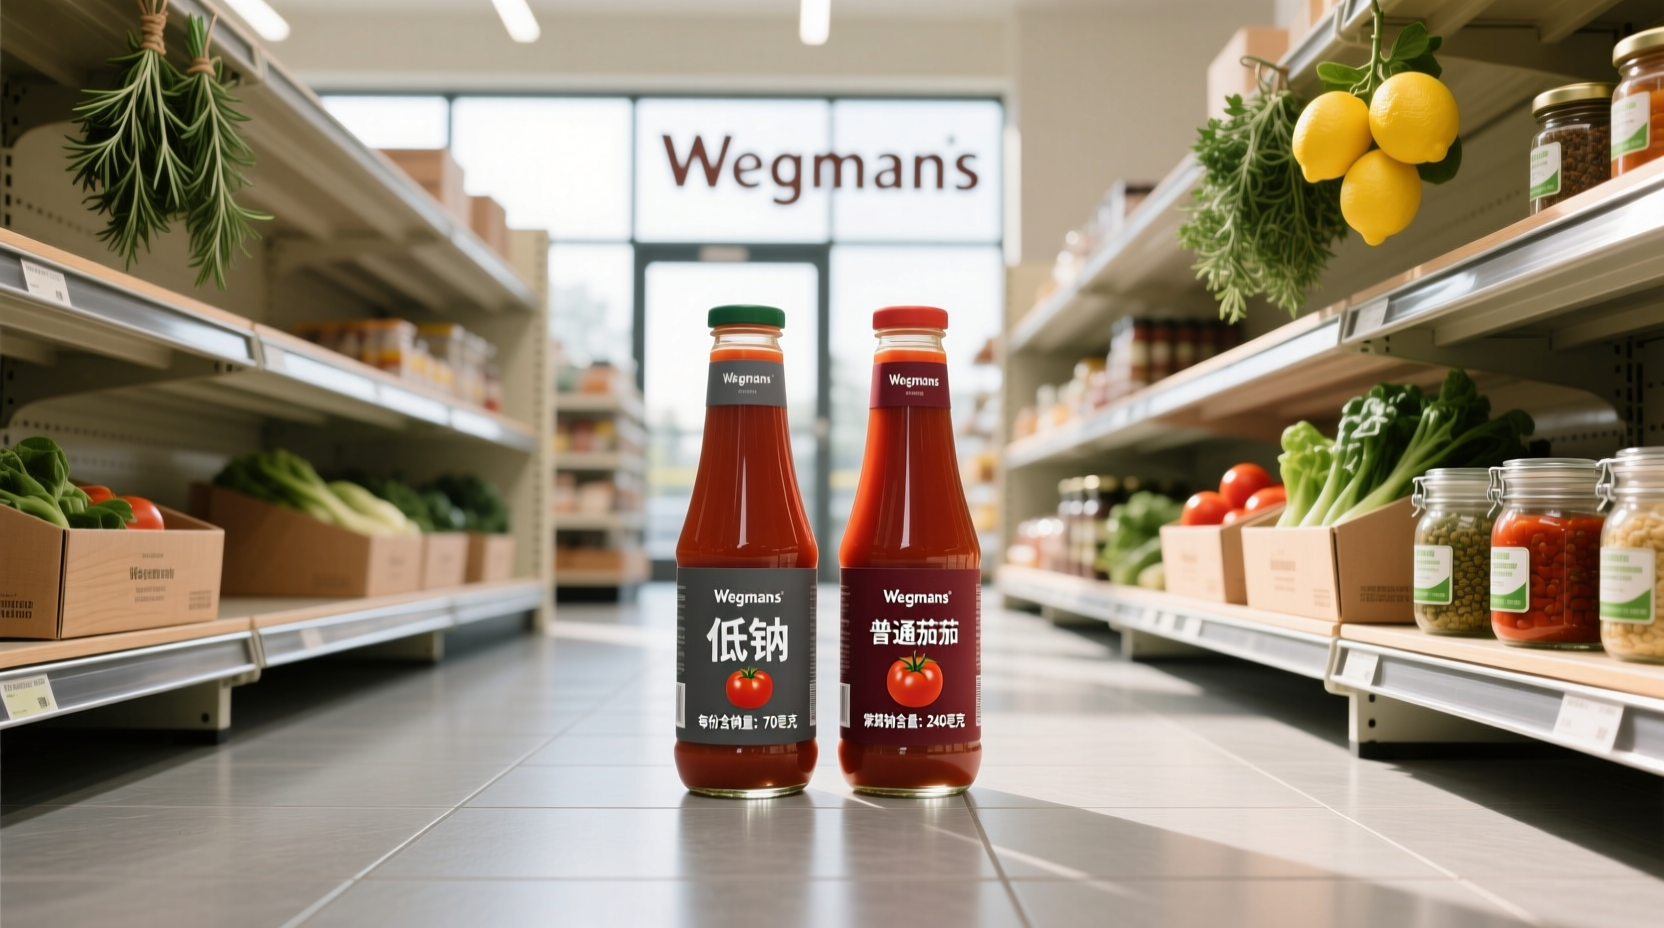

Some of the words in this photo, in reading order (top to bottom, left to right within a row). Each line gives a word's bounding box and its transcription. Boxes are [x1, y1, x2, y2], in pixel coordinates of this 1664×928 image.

[883, 589, 950, 608] Wegmans
[706, 616, 789, 663] 低钠
[869, 618, 960, 646] 普通茄茄
